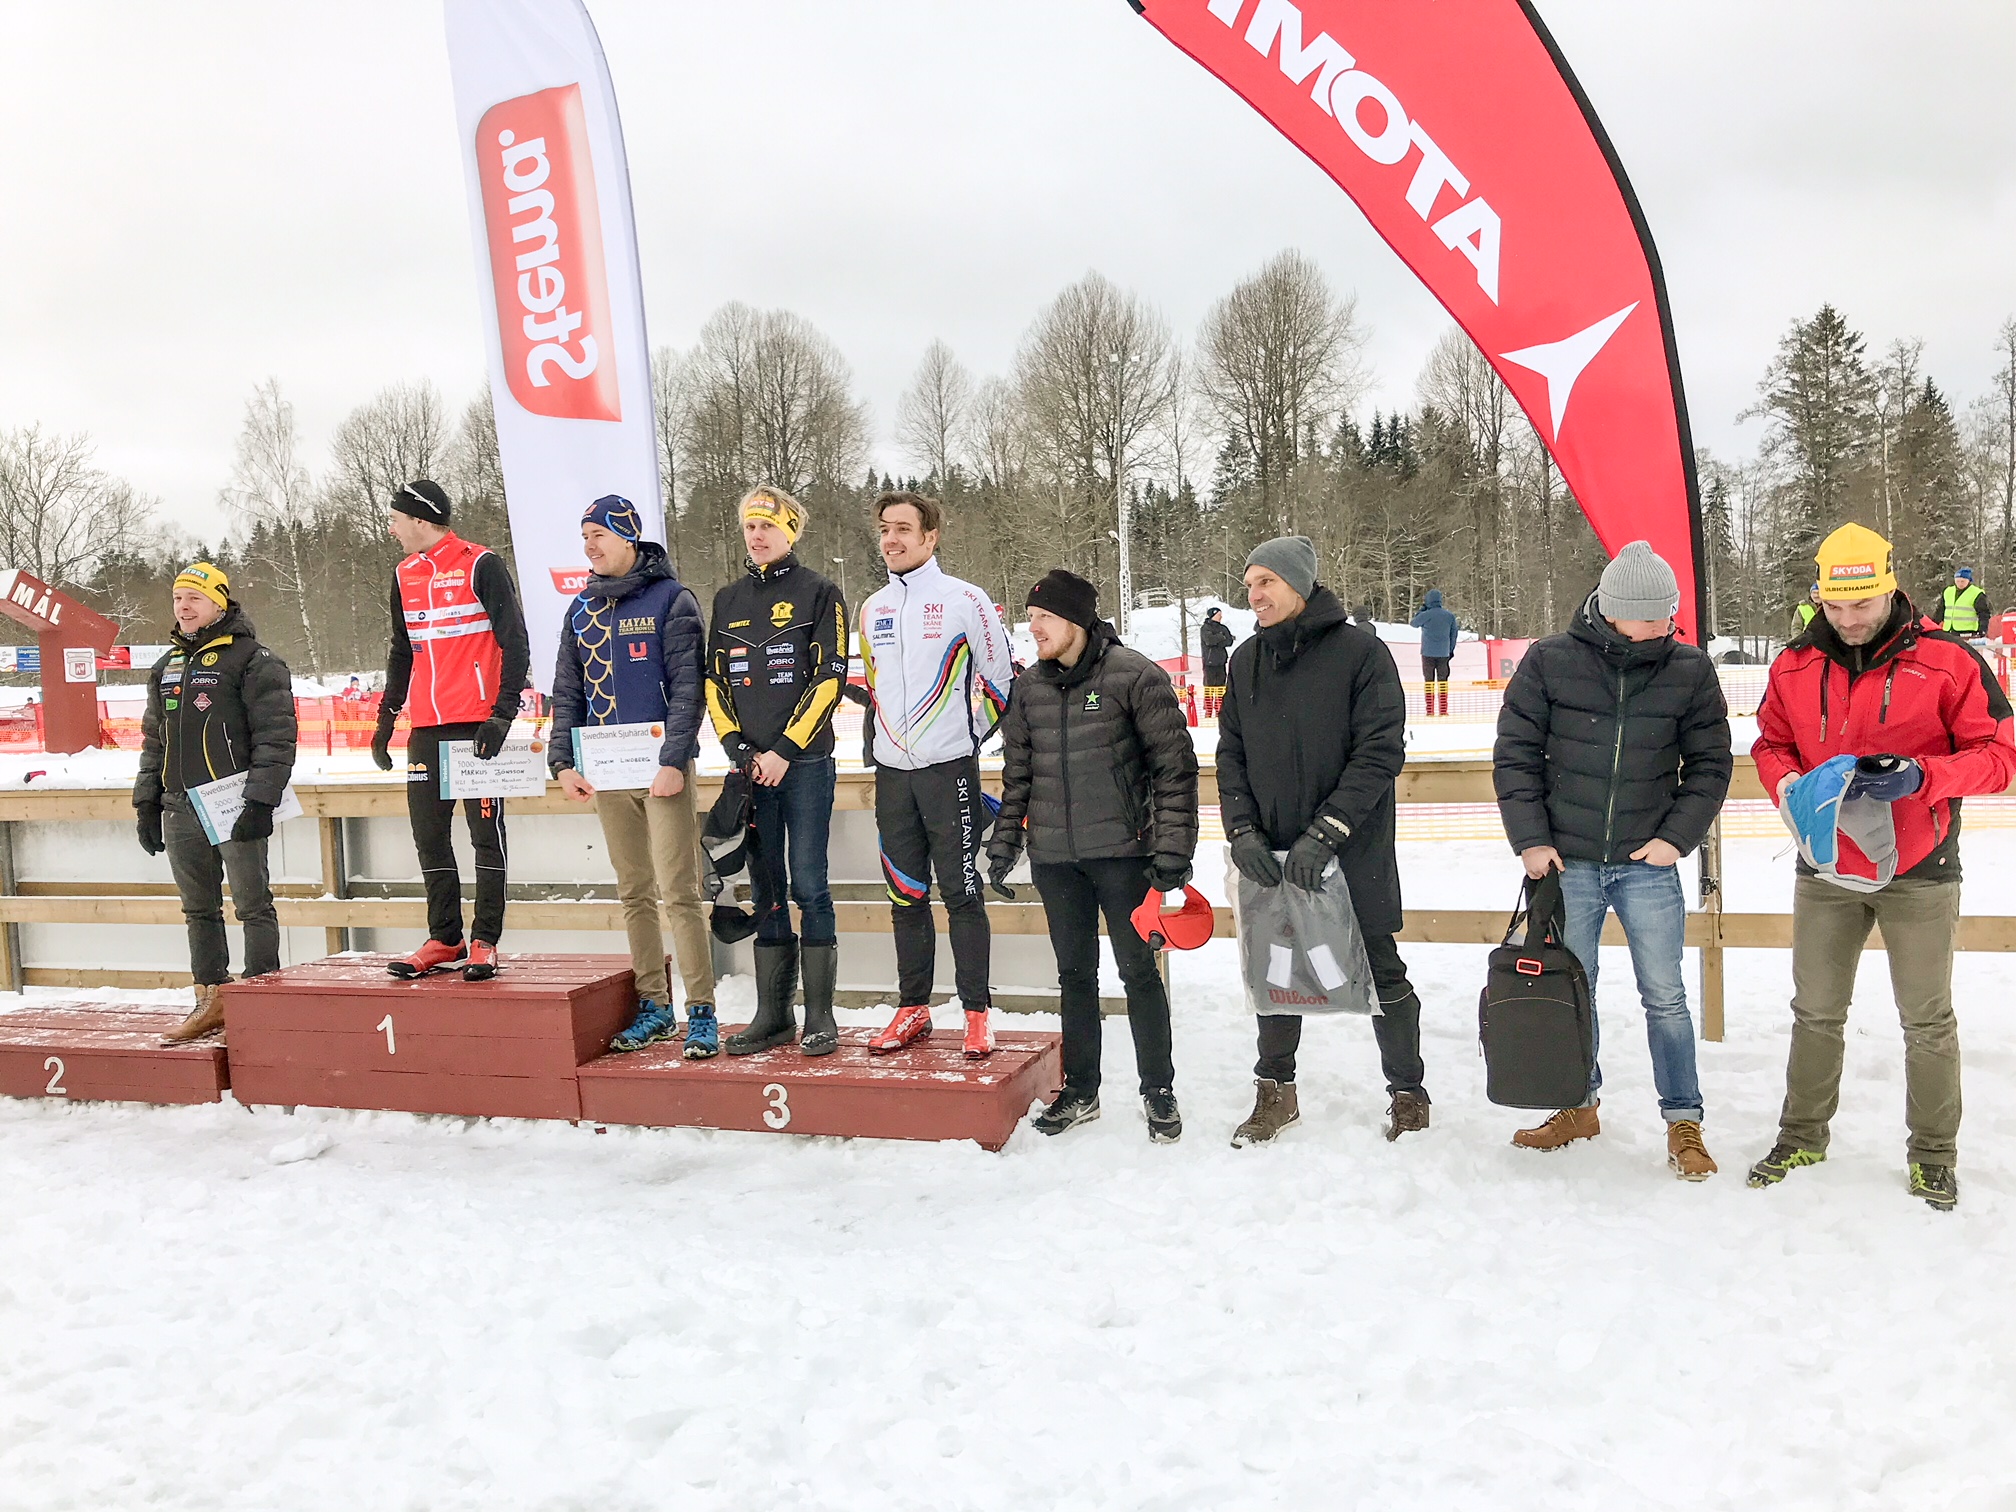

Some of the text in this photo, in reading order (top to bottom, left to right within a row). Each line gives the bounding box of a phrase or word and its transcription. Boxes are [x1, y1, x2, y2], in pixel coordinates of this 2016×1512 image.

[1832, 565, 1873, 576] SKYDDA
[1825, 584, 1874, 592] ULRICEHAMNS
[11, 581, 62, 626] MÅL
[923, 603, 944, 613] SKI
[618, 616, 656, 628] KAYAK
[728, 619, 751, 629] TRIMTEX
[962, 590, 995, 663] SKI TEAM SKÅNE
[767, 657, 795, 667] JOBRO
[831, 661, 846, 674] 157
[191, 677, 218, 685] JOBRO
[769, 677, 793, 685] SPORTIA
[582, 728, 649, 740] Swedbank Sjuhärad
[451, 744, 528, 754] Swed uhärad
[461, 769, 488, 777] MARKUS
[200, 780, 238, 798] Swedbank
[957, 777, 976, 895] SKI TEAM SKÅNE
[1267, 988, 1329, 1005] Wilson
[376, 1013, 396, 1055] 1
[44, 1056, 67, 1094] 2
[762, 1083, 791, 1130] 3
